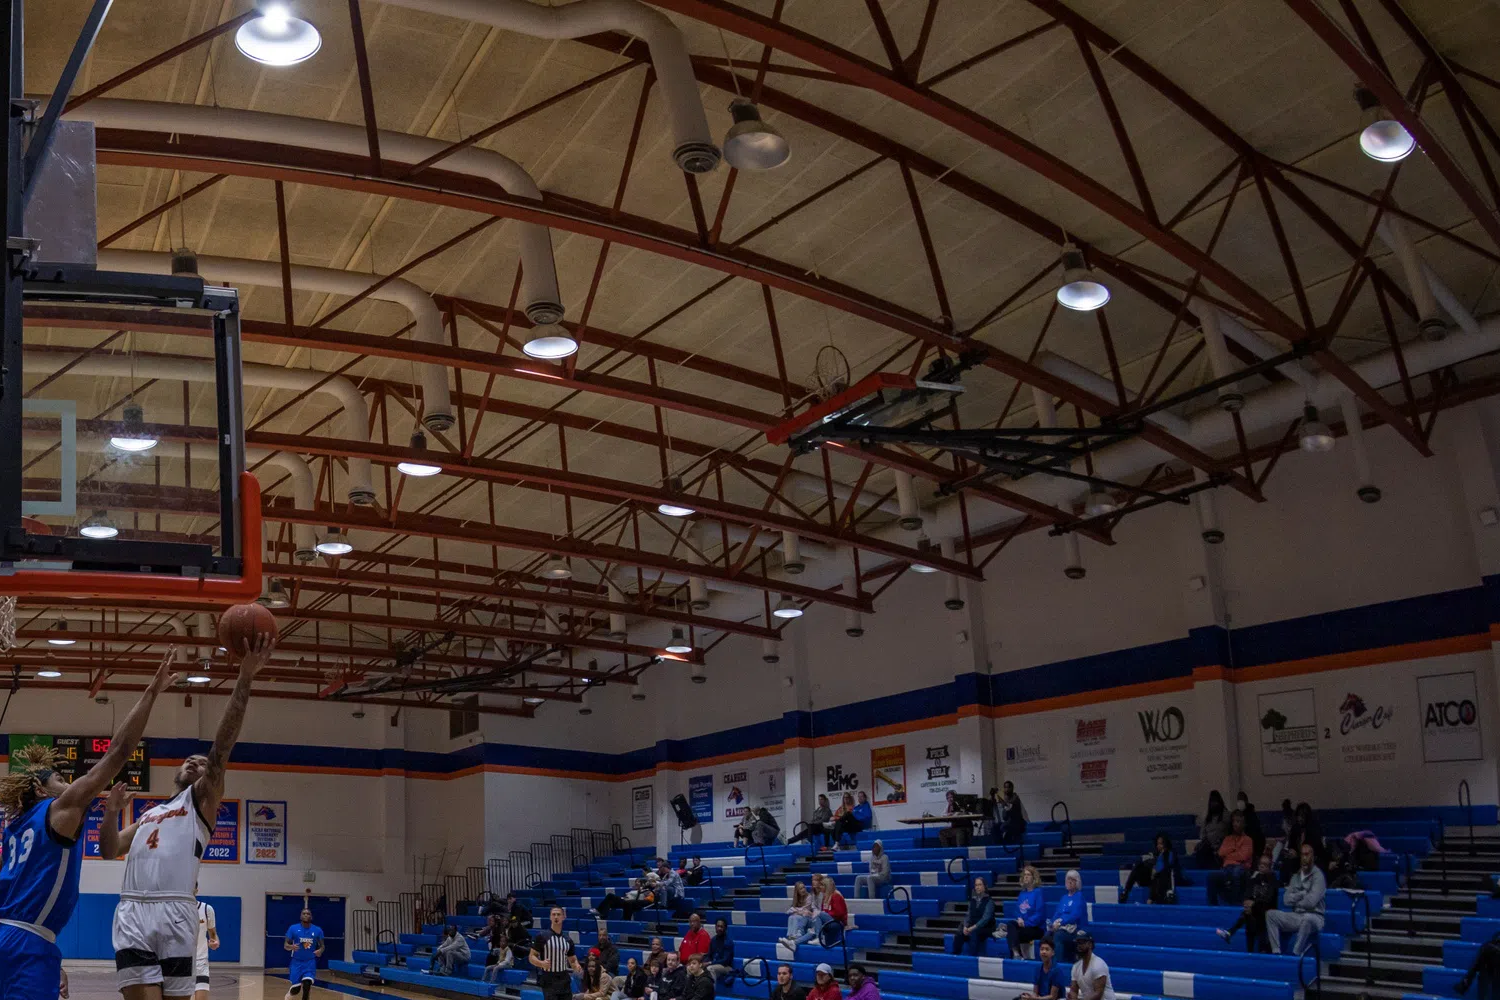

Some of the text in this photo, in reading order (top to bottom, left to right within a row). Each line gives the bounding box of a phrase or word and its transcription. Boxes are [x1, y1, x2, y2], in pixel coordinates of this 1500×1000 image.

[1425, 699, 1476, 728] ATCO
[1340, 712, 1372, 735] Charger
[1323, 727, 1331, 739] 2
[92, 738, 112, 753] 6:2
[1015, 744, 1041, 759] United
[66, 746, 77, 760] 16
[132, 775, 140, 785] 4
[723, 771, 747, 784] CHARGER
[970, 773, 976, 784] 3
[146, 828, 160, 850] 4
[8, 828, 35, 871] 33
[208, 847, 230, 857] 2022
[256, 848, 277, 858] 2022
